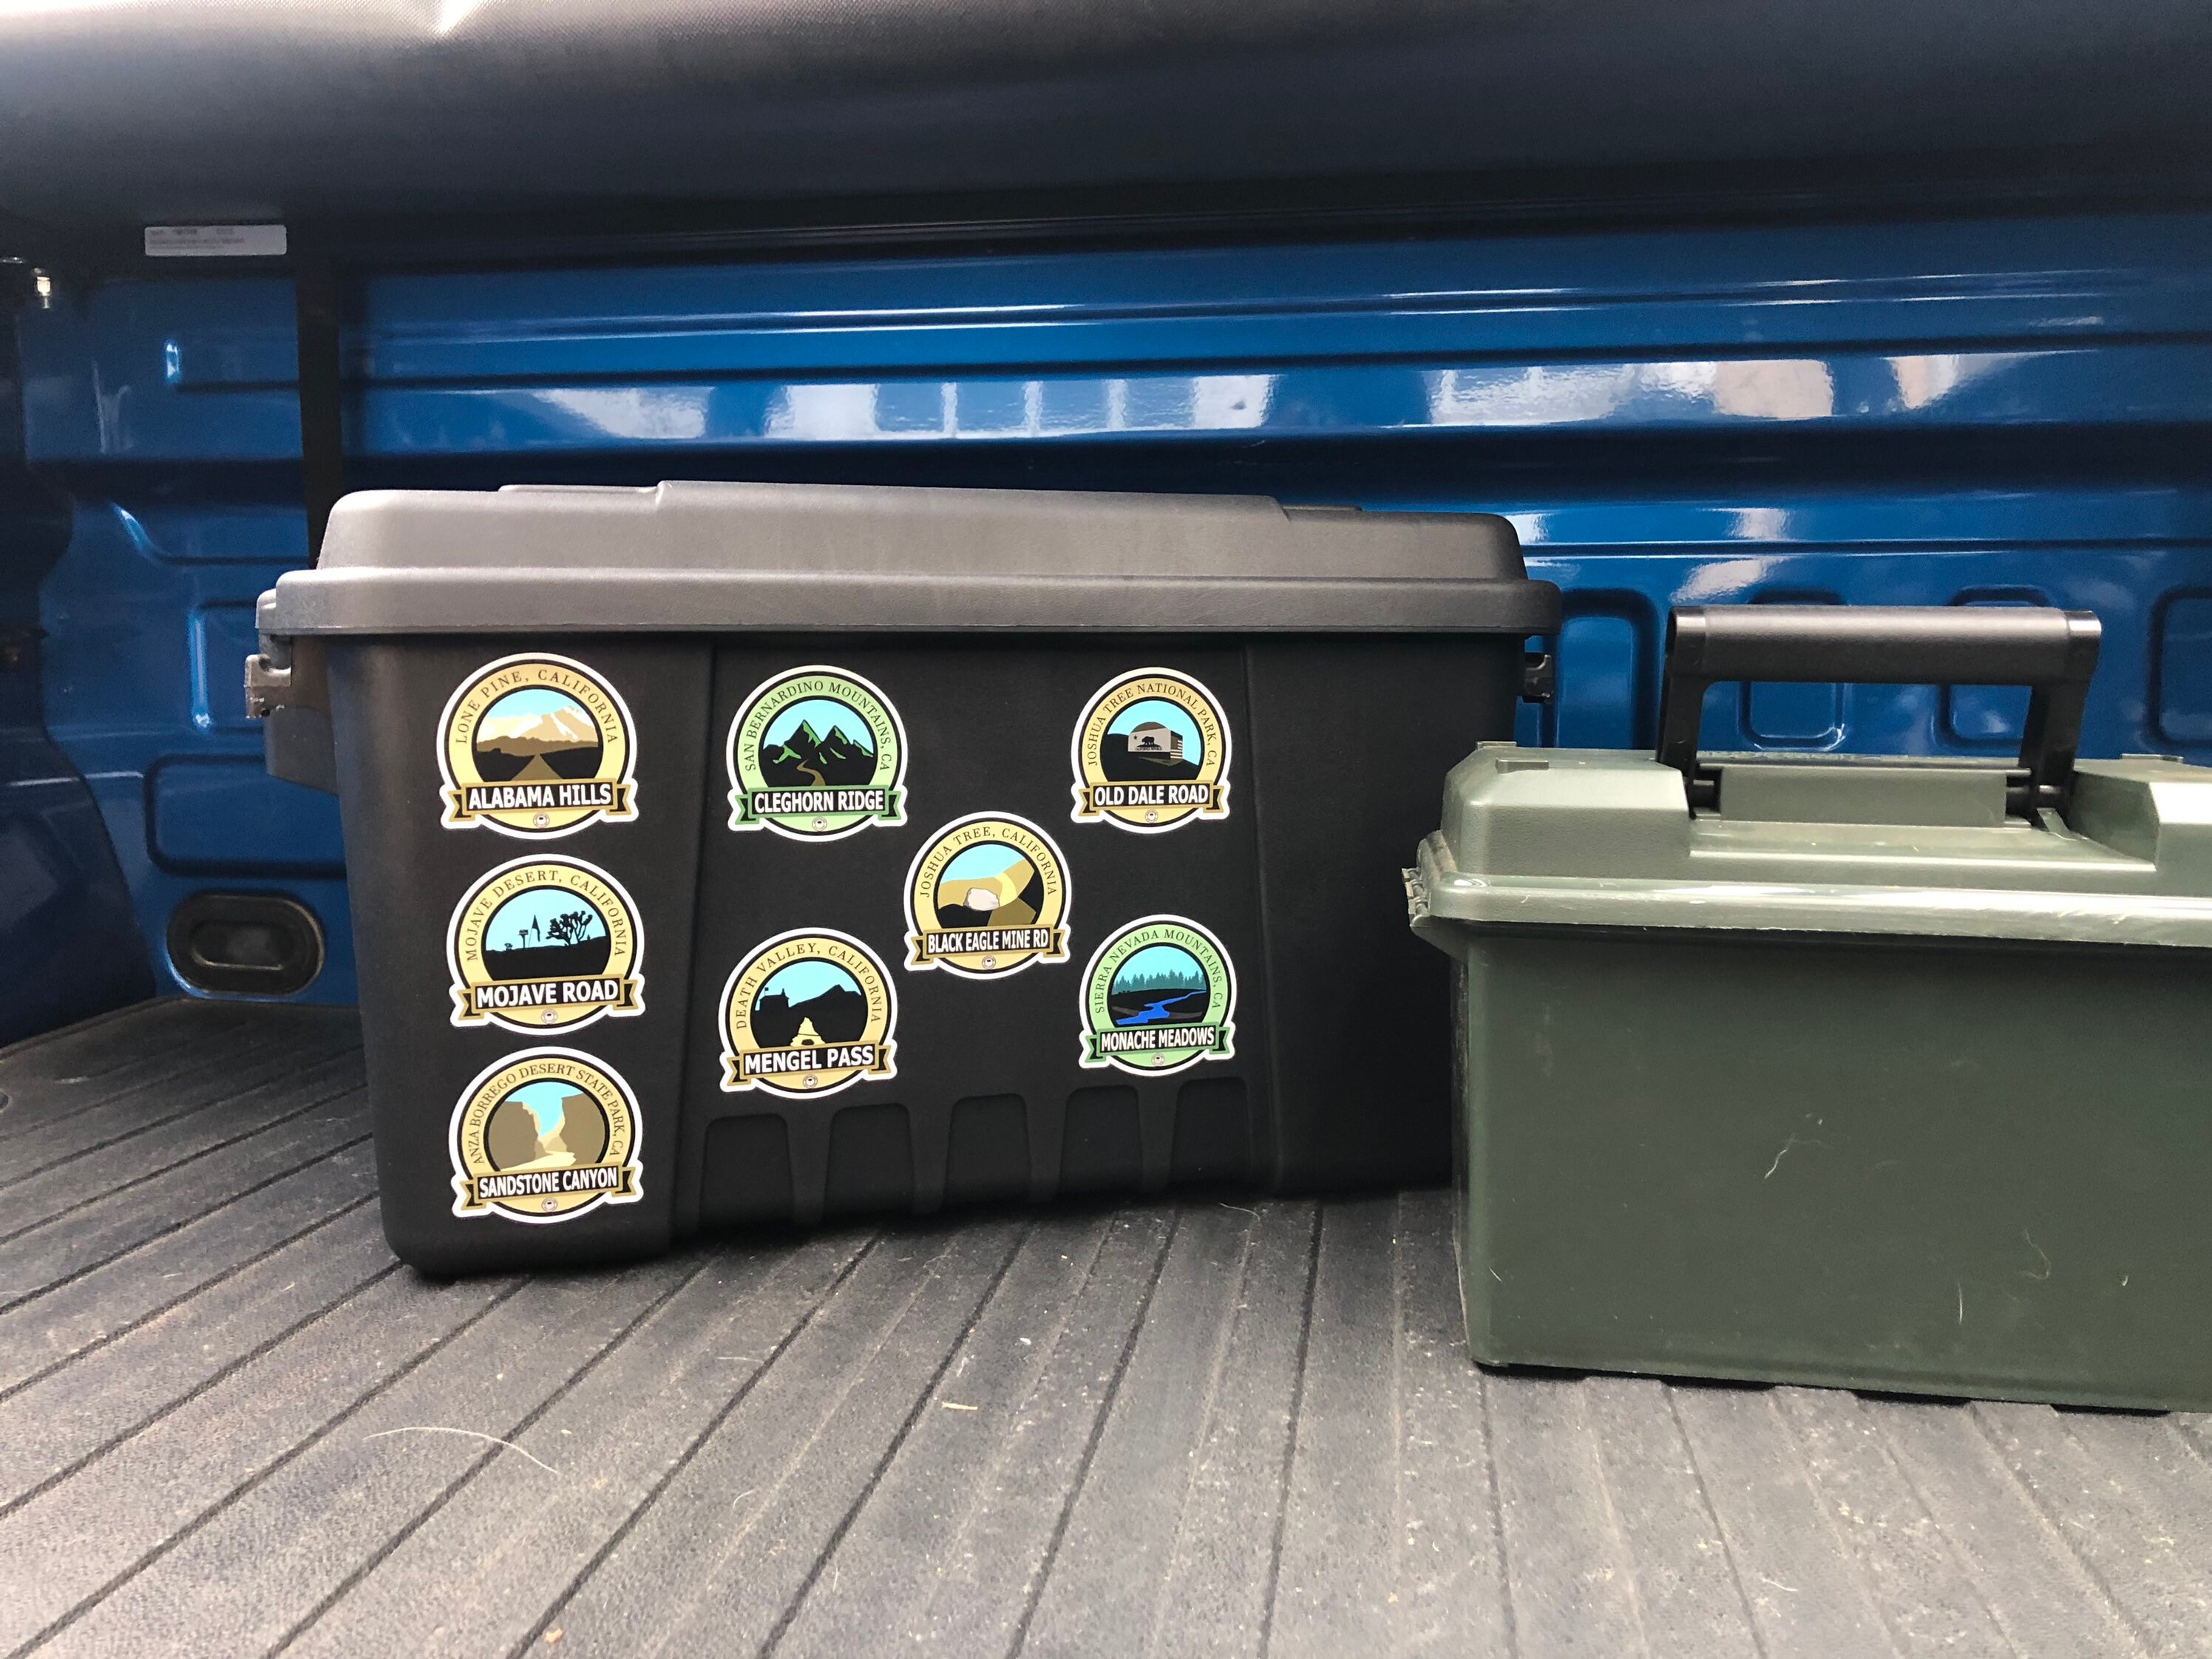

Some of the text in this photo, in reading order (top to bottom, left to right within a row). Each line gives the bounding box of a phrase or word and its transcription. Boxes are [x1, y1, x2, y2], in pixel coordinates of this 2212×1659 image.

[456, 669, 617, 744] LONE PINE, CALIFORNIA
[744, 681, 892, 770] SAN BERNARDINO MOUNTAINS, CA
[1088, 683, 1217, 766] JOSHUA TREE NATIONAL PARK, CA
[469, 784, 611, 809] ALABAMA HILLS
[755, 790, 883, 813] CLEGHORN RIDGE
[1095, 785, 1208, 805] OLD DALE ROAD
[920, 827, 1056, 897] JOSHUA TREE, CALIFORNIA
[466, 870, 627, 960] MOJAVE DESERT, CALIFORNIA
[928, 929, 1048, 953] BLACK EAGLE MINE RD
[477, 980, 618, 1008] MOJAVE ROAD
[736, 943, 881, 1029] DEATH VALLEY, CALIFORNIA
[1095, 929, 1223, 1014] SIERRA NEVADA MOUNTAINS, CA
[744, 1046, 873, 1073] MENGEL PASS
[1102, 1027, 1214, 1051] MONACHE MEADOWS
[469, 1064, 625, 1164] ANZA BORREGO DESERT STATE PARK, CA
[481, 1167, 617, 1198] SANDSTONE CANYON
